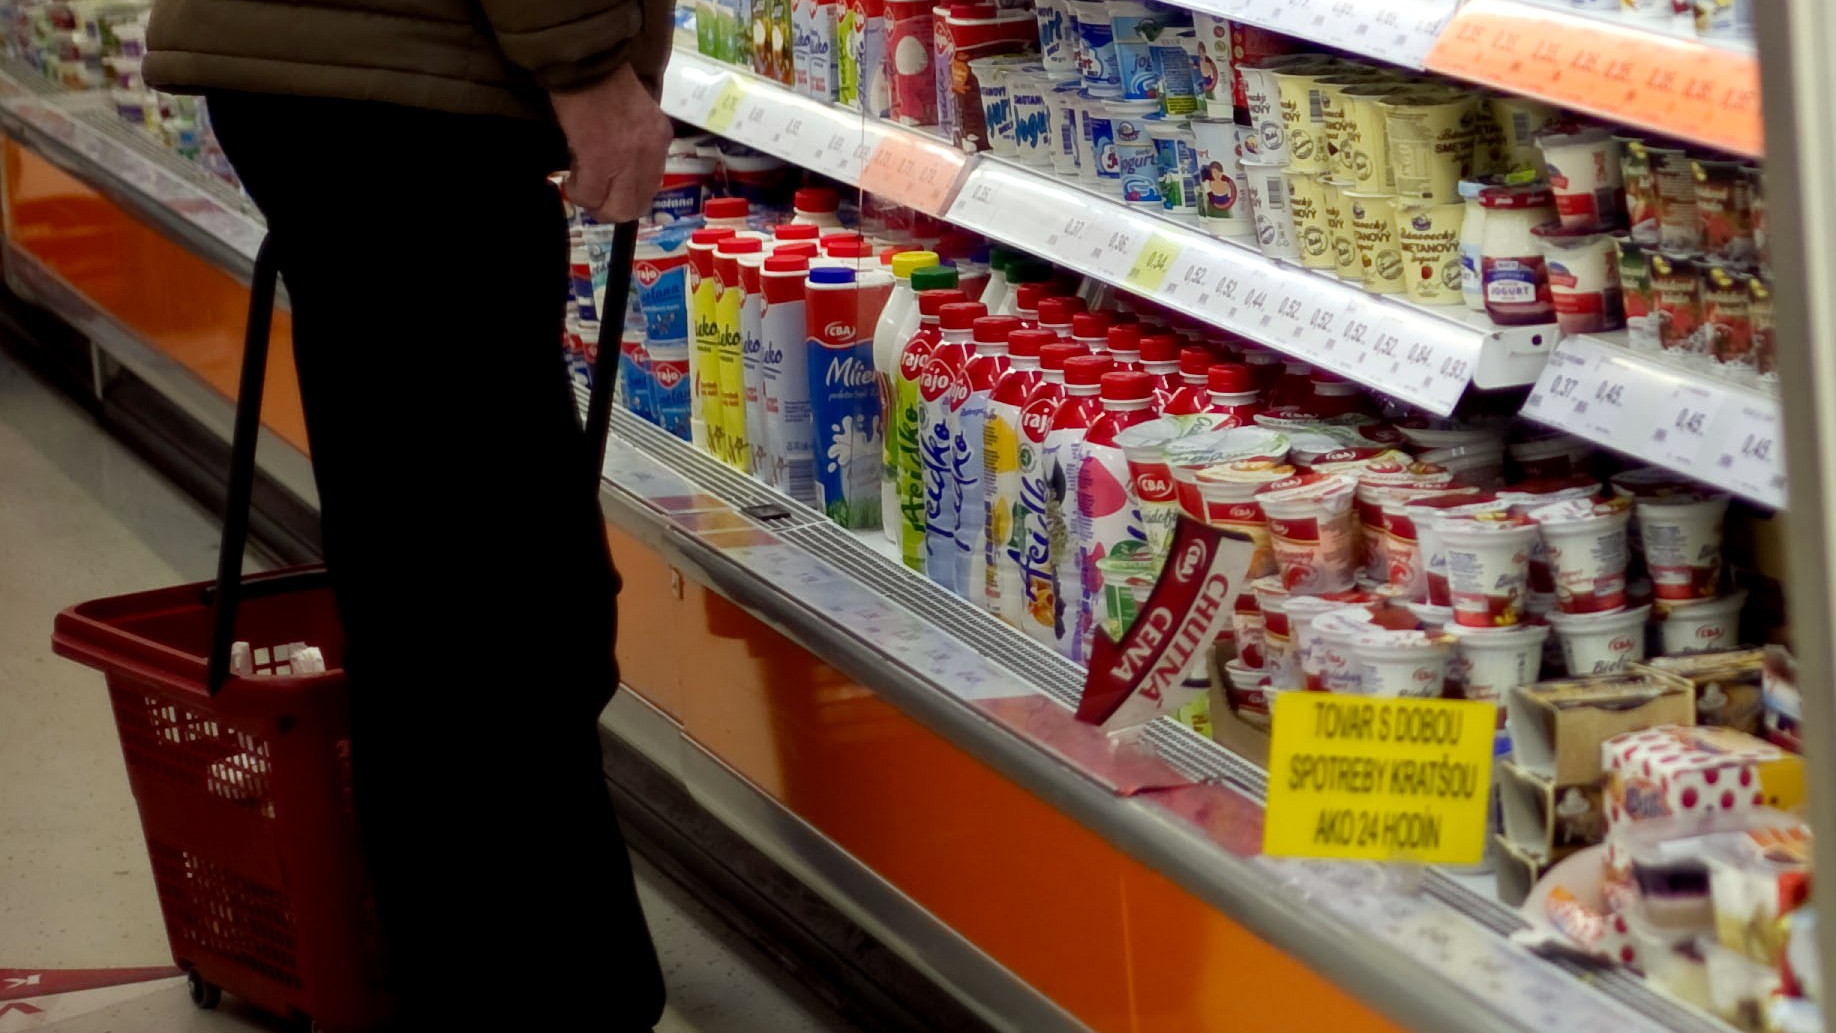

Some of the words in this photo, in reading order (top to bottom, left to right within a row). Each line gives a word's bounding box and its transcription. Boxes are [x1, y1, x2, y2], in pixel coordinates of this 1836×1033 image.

[827, 323, 854, 338] CBA
[901, 346, 929, 370] rajo
[919, 368, 949, 396] rajo
[1139, 476, 1170, 495] CBA
[1110, 606, 1173, 681] CENA
[1139, 572, 1229, 709] CHUTNÁ
[1313, 702, 1375, 739] TOVAR
[1378, 705, 1392, 742] S
[1394, 707, 1464, 745] DOBOU
[1288, 754, 1387, 794] SPOTREBY
[1390, 753, 1479, 799] KRATŠOU
[1313, 808, 1354, 845] AKO
[1356, 810, 1379, 847] 24
[1382, 805, 1442, 849] HODÍN
